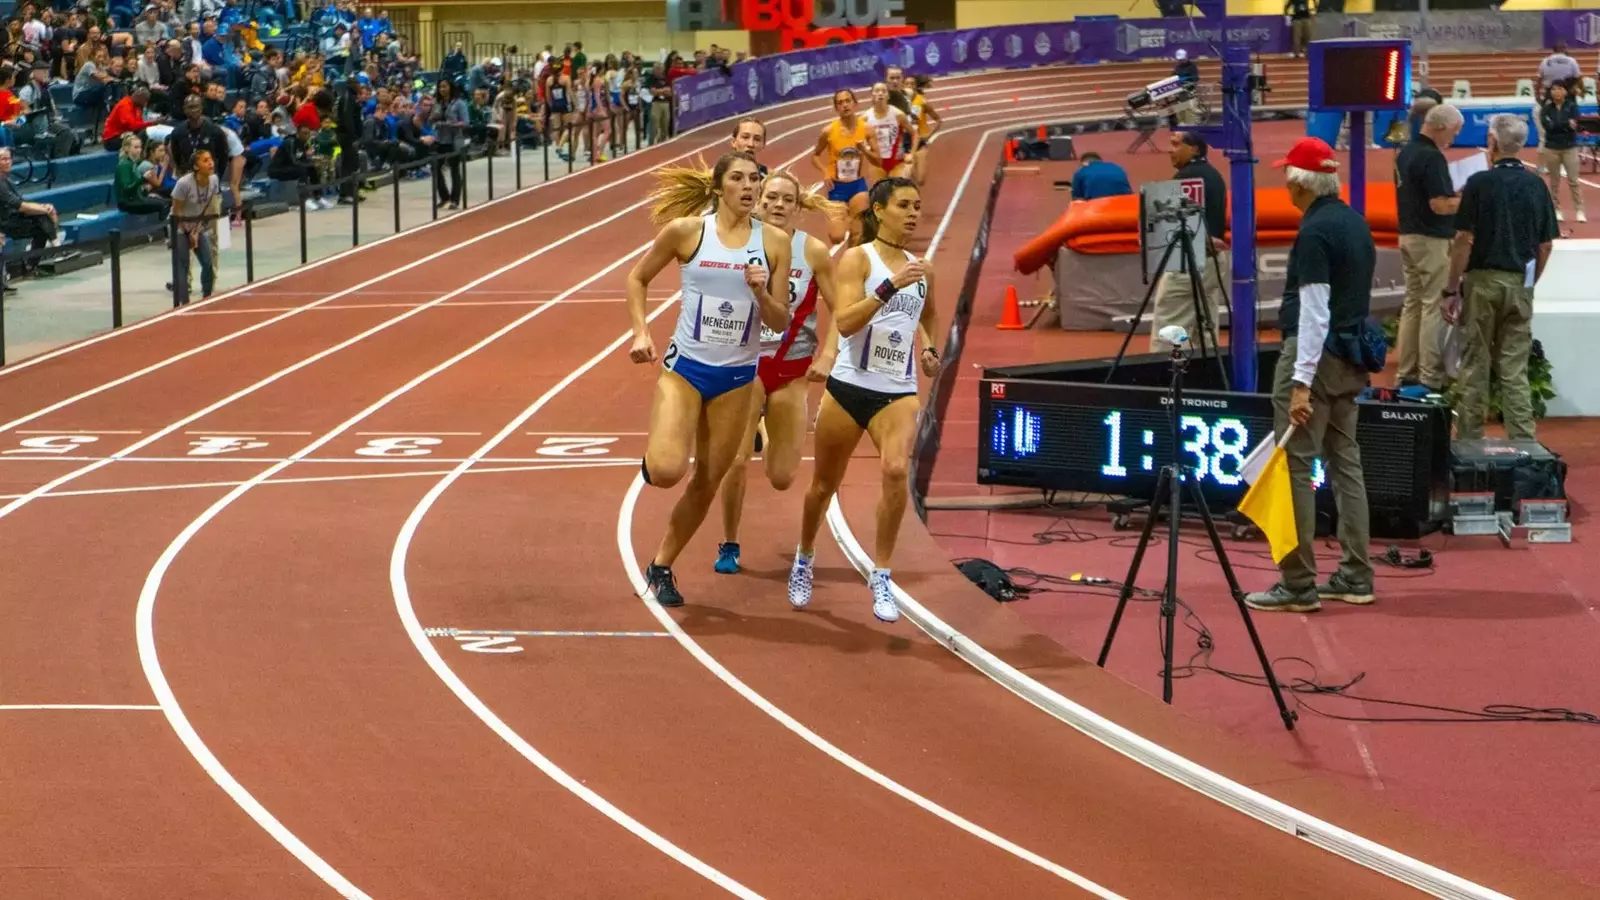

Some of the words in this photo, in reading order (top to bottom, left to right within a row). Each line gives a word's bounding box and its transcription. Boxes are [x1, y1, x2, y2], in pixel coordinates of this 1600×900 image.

[1181, 183, 1203, 204] RT
[702, 315, 746, 331] MENEGATTI
[663, 343, 678, 369] 2
[874, 345, 906, 364] ROVERE
[991, 383, 1006, 394] RT
[1160, 396, 1228, 409] DATRONICS
